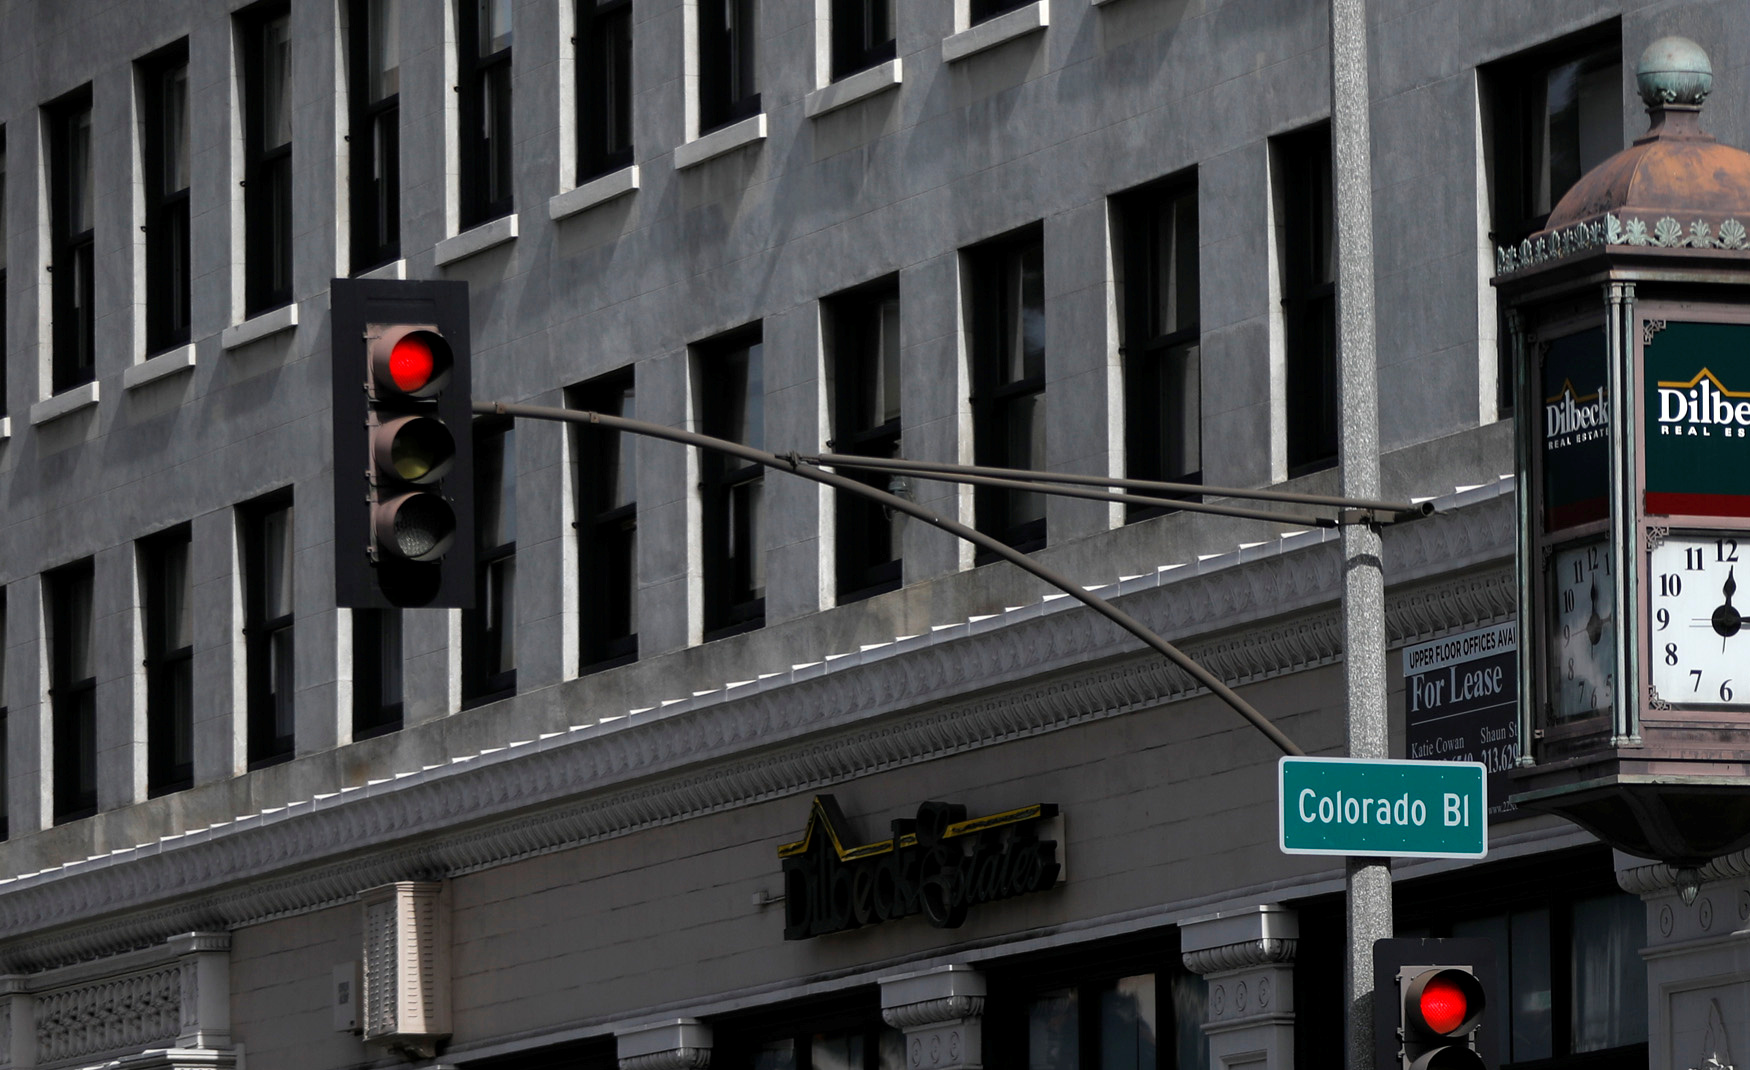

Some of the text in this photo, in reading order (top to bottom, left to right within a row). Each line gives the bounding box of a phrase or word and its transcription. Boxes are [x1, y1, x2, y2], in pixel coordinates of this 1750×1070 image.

[1546, 385, 1609, 438] Dilbeck
[1661, 425, 1711, 436] REAL
[1548, 436, 1572, 451] REAL
[1587, 546, 1599, 571] 12
[1685, 547, 1705, 571] 11
[1714, 538, 1739, 562] 12
[1573, 560, 1584, 584] 11
[1659, 573, 1682, 597] 10
[1563, 588, 1575, 614] 10
[1656, 608, 1670, 631] 9
[1563, 624, 1571, 648] 9
[1409, 648, 1435, 669] UPPER
[1436, 641, 1462, 663] FLOOR
[1463, 632, 1496, 655] OFFICES
[1665, 642, 1678, 666] 8
[1567, 658, 1574, 681] 8
[1689, 669, 1703, 693] 7
[1411, 666, 1503, 712] For Lease
[1578, 681, 1585, 704] 7
[1590, 687, 1598, 710] 6
[1719, 679, 1733, 702] 6
[1480, 725, 1506, 744] Shaun
[1412, 739, 1434, 759] Katie
[1436, 737, 1465, 754] Cowan
[1298, 788, 1469, 827] Colorado Bl
